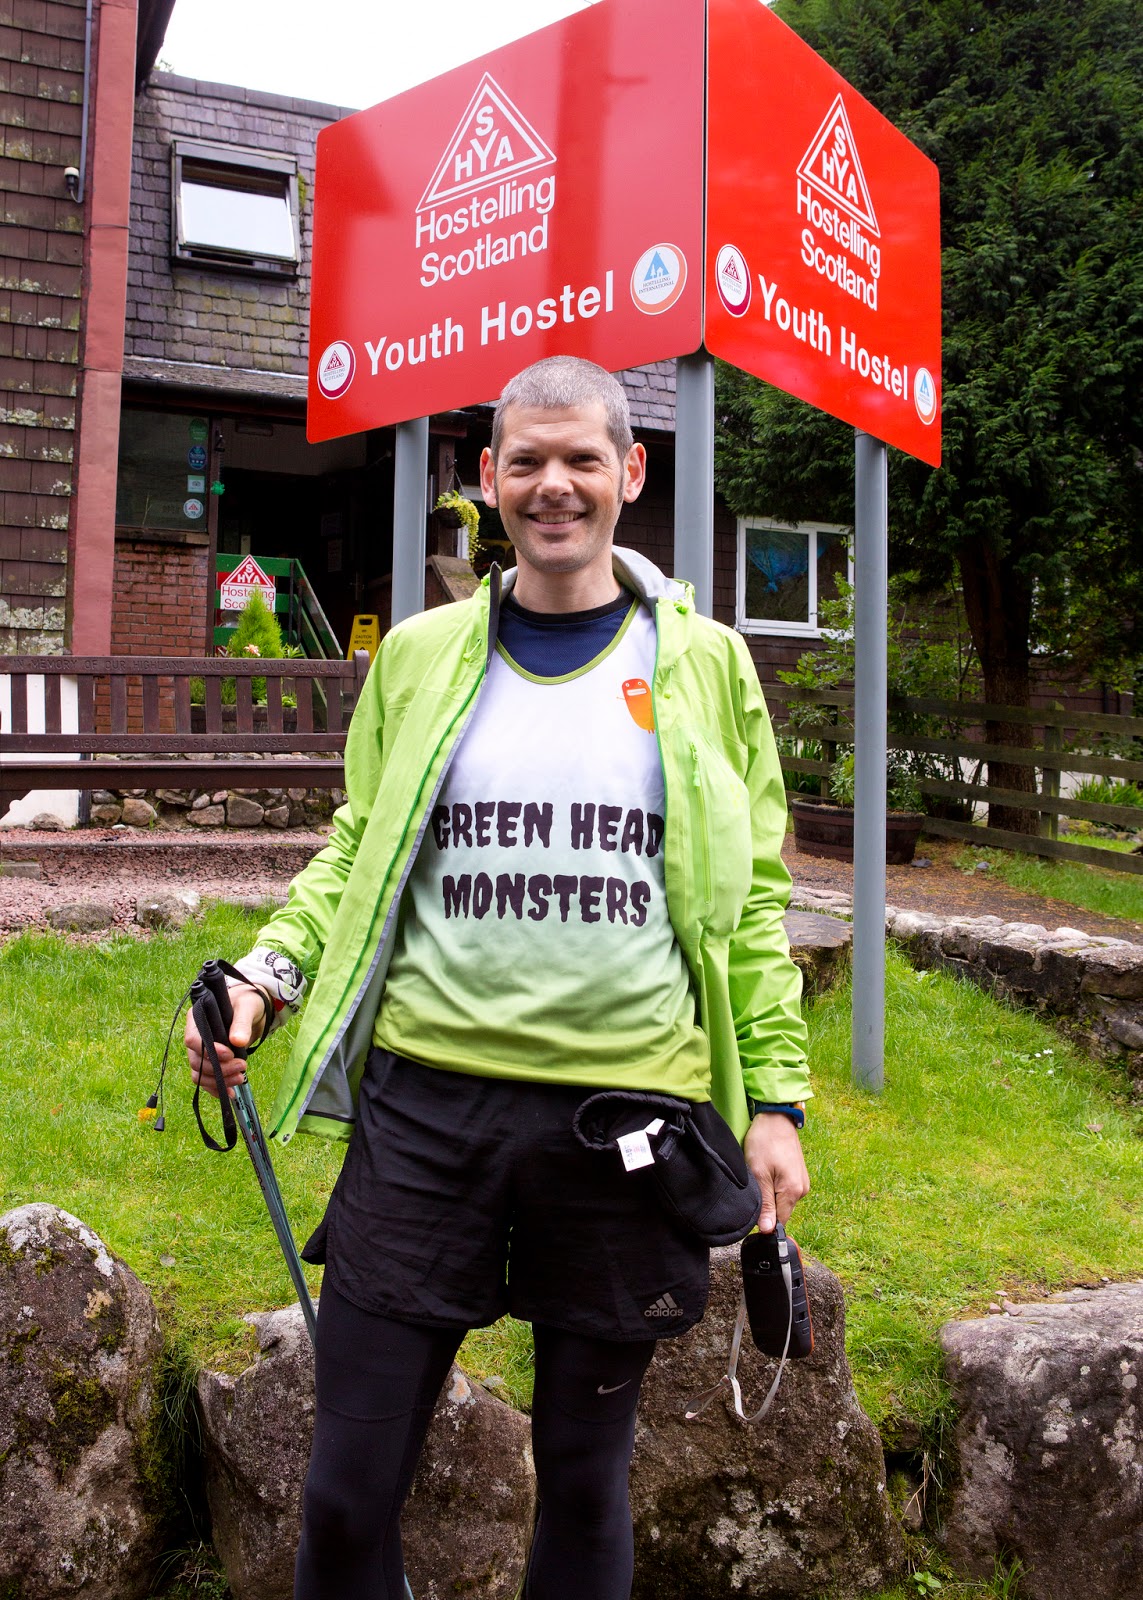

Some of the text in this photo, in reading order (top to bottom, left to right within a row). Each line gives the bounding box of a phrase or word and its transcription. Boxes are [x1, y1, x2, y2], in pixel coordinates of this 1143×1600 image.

[415, 175, 556, 248] Hostelling
[797, 178, 881, 279] Hostelling
[419, 214, 548, 287] Scotland
[801, 228, 878, 311] Scotland
[364, 270, 614, 376] Youth Hostel
[758, 273, 908, 401] Youth Hostel
[30, 659, 77, 670] MEMORY
[85, 660, 98, 670] OF
[105, 660, 125, 671] OUR
[134, 660, 186, 672] HIGHLAND
[254, 662, 286, 673] DAVID
[431, 800, 664, 857] GREEN HEAD
[442, 872, 651, 927] MONSTERS
[644, 1308, 684, 1317] adidas
